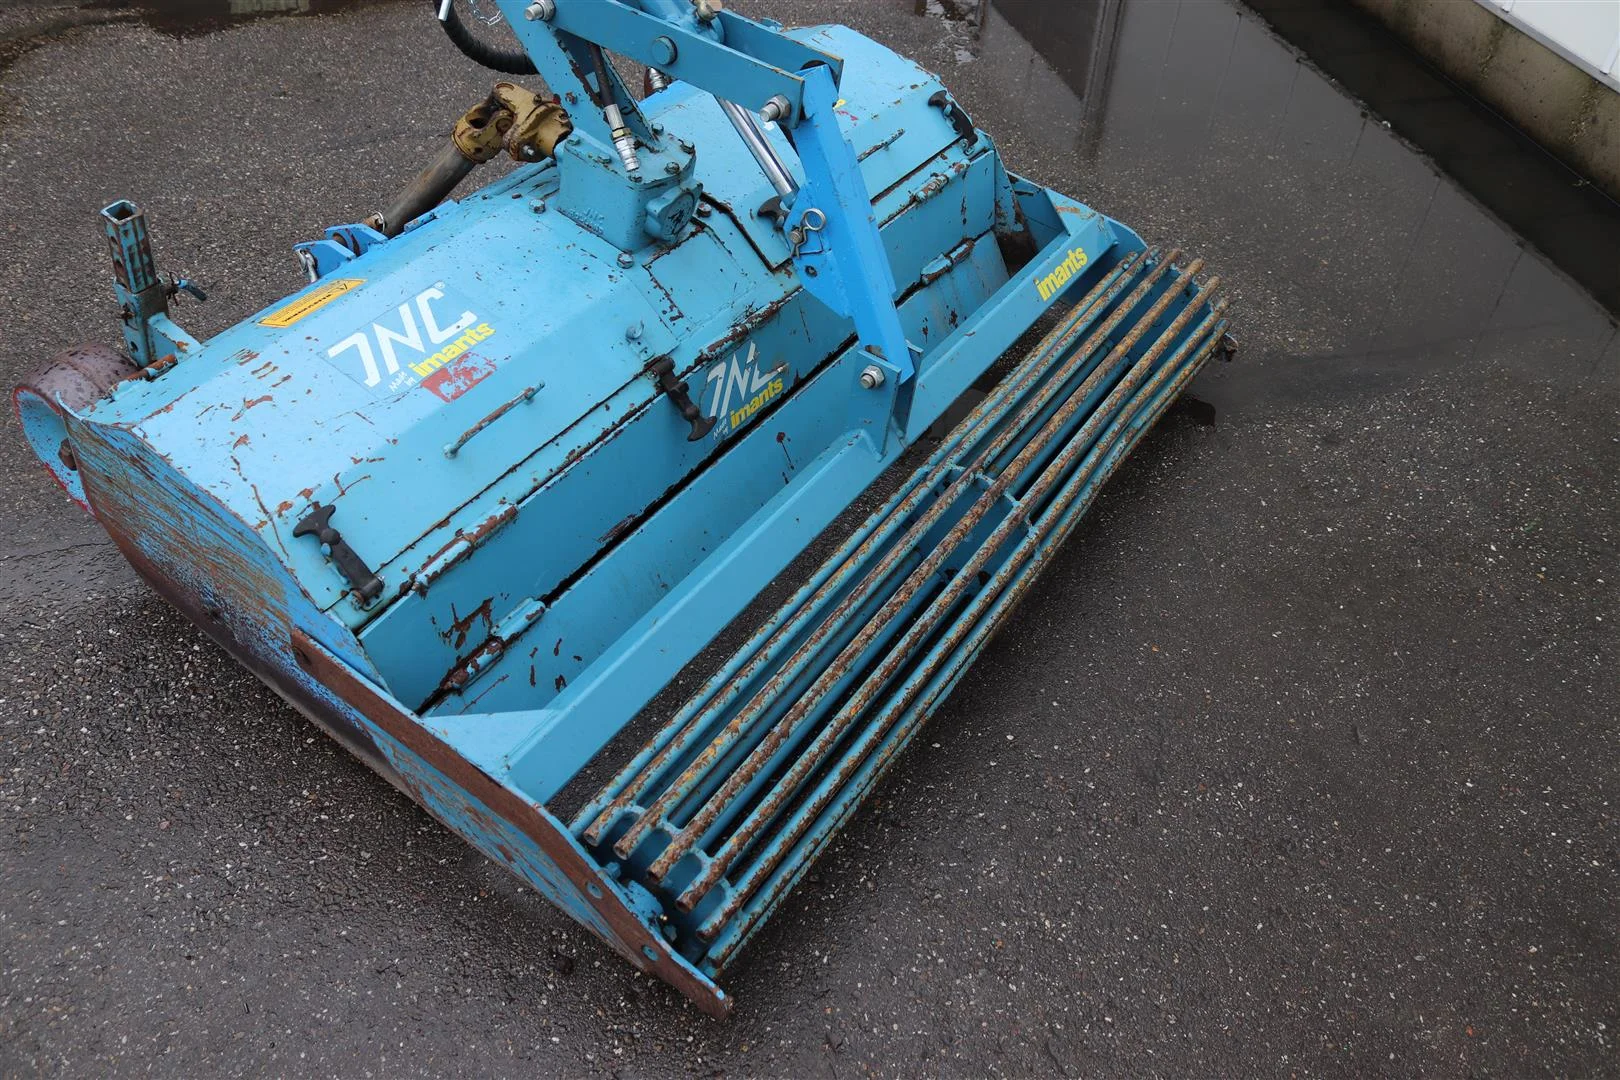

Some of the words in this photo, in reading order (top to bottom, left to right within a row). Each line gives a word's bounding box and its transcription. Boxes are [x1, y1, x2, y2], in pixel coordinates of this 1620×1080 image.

[1033, 247, 1088, 302] imants
[408, 322, 497, 378] imants
[730, 378, 784, 430] imants
